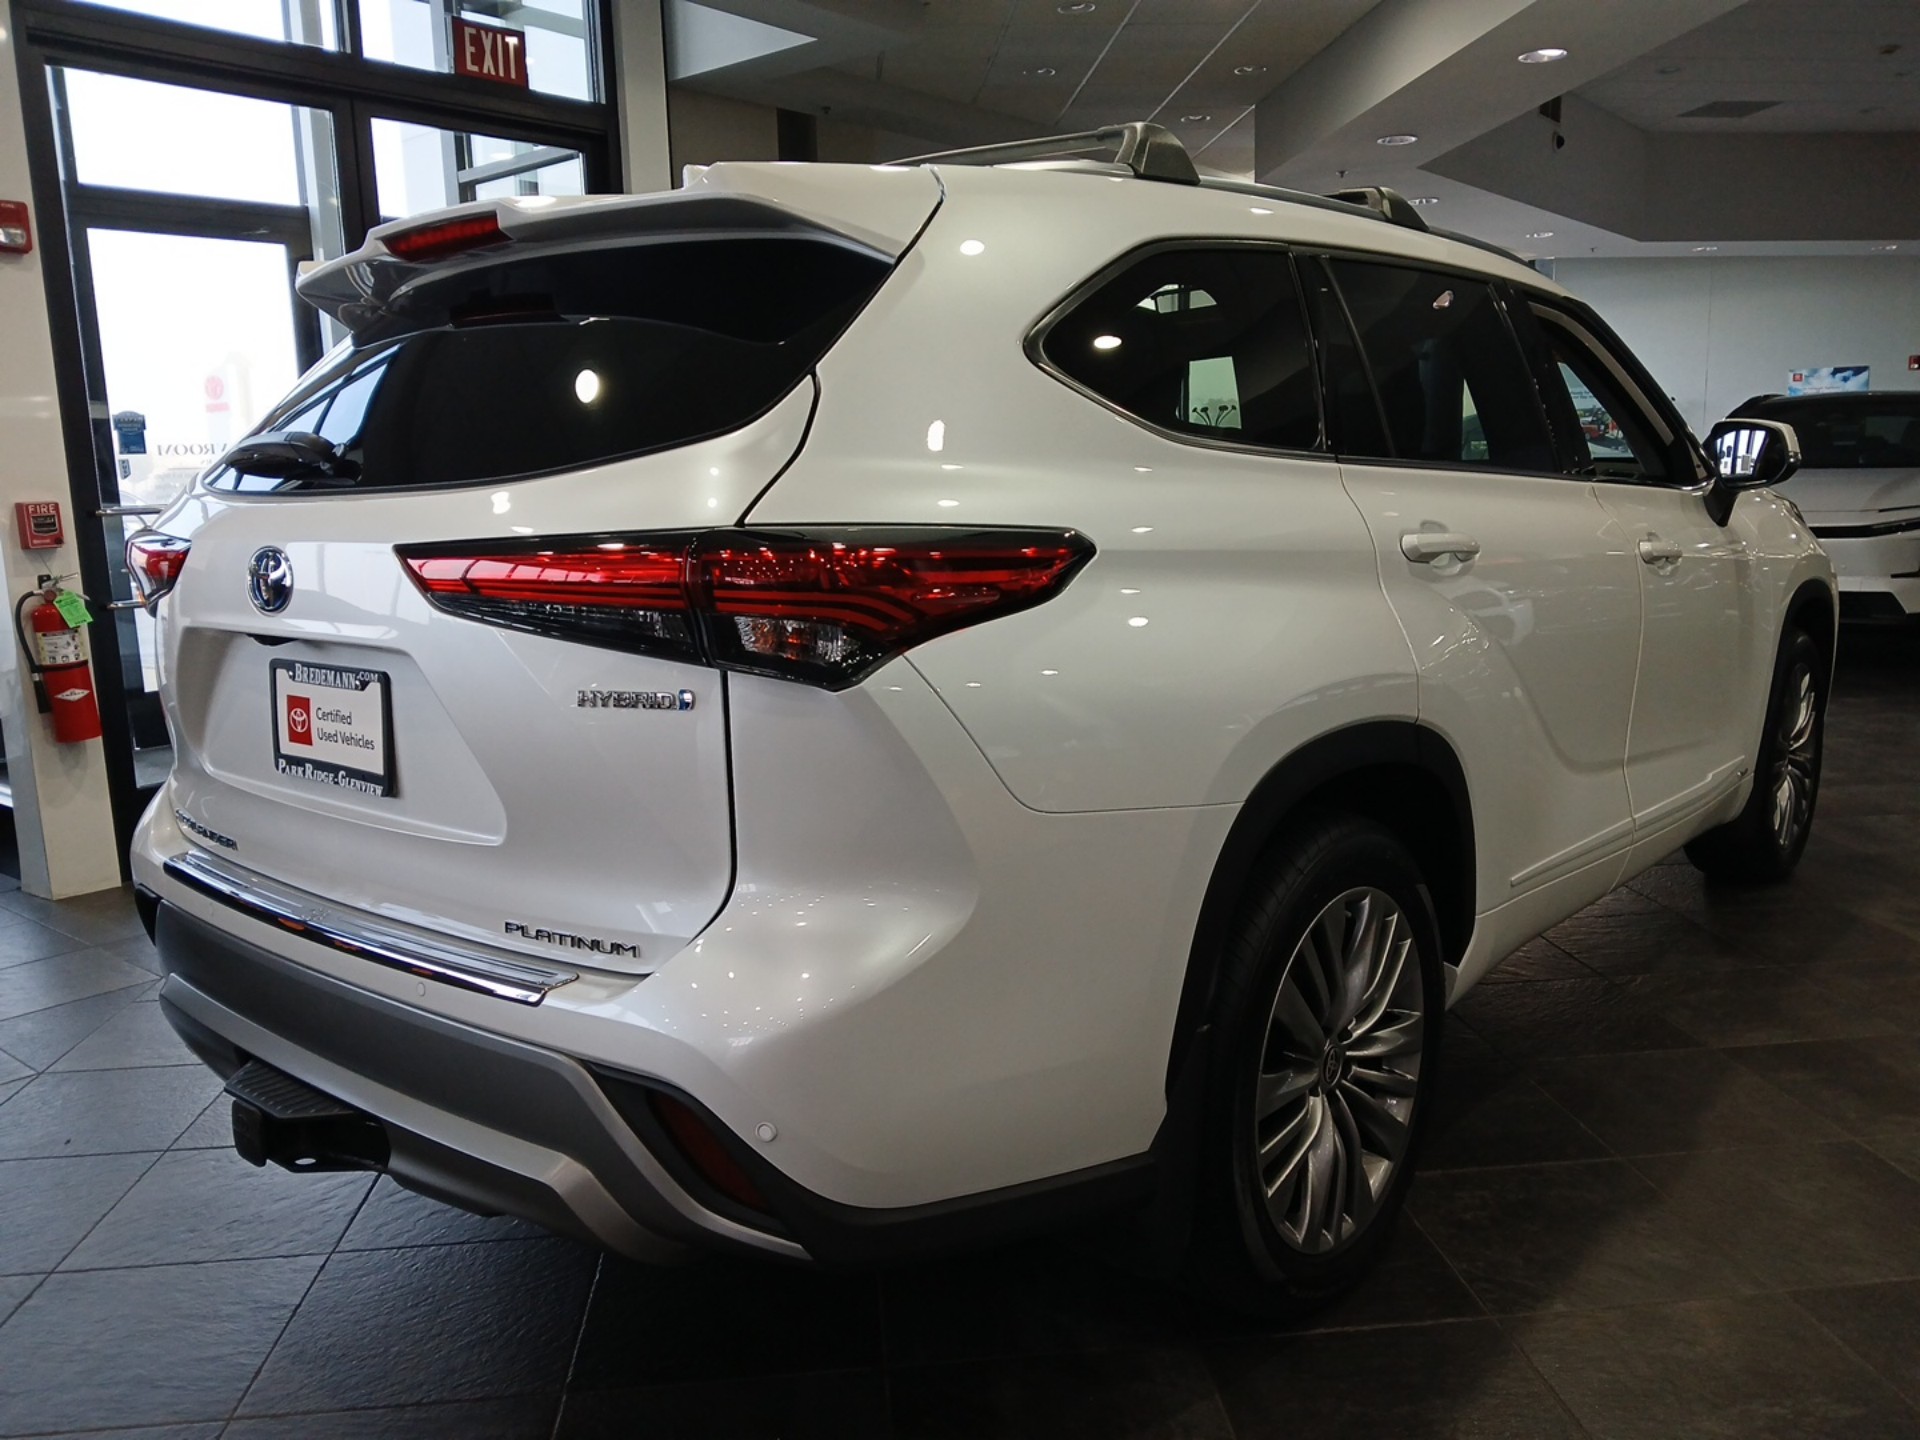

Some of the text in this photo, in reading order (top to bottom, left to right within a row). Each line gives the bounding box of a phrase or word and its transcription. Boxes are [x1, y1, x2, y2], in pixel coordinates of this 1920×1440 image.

[463, 26, 519, 80] EXIT
[27, 503, 57, 515] FIRE
[577, 690, 677, 711] HYBRID
[315, 707, 352, 725] Certified
[316, 727, 375, 750] Used Vehicles
[504, 920, 641, 958] PLATINUM
